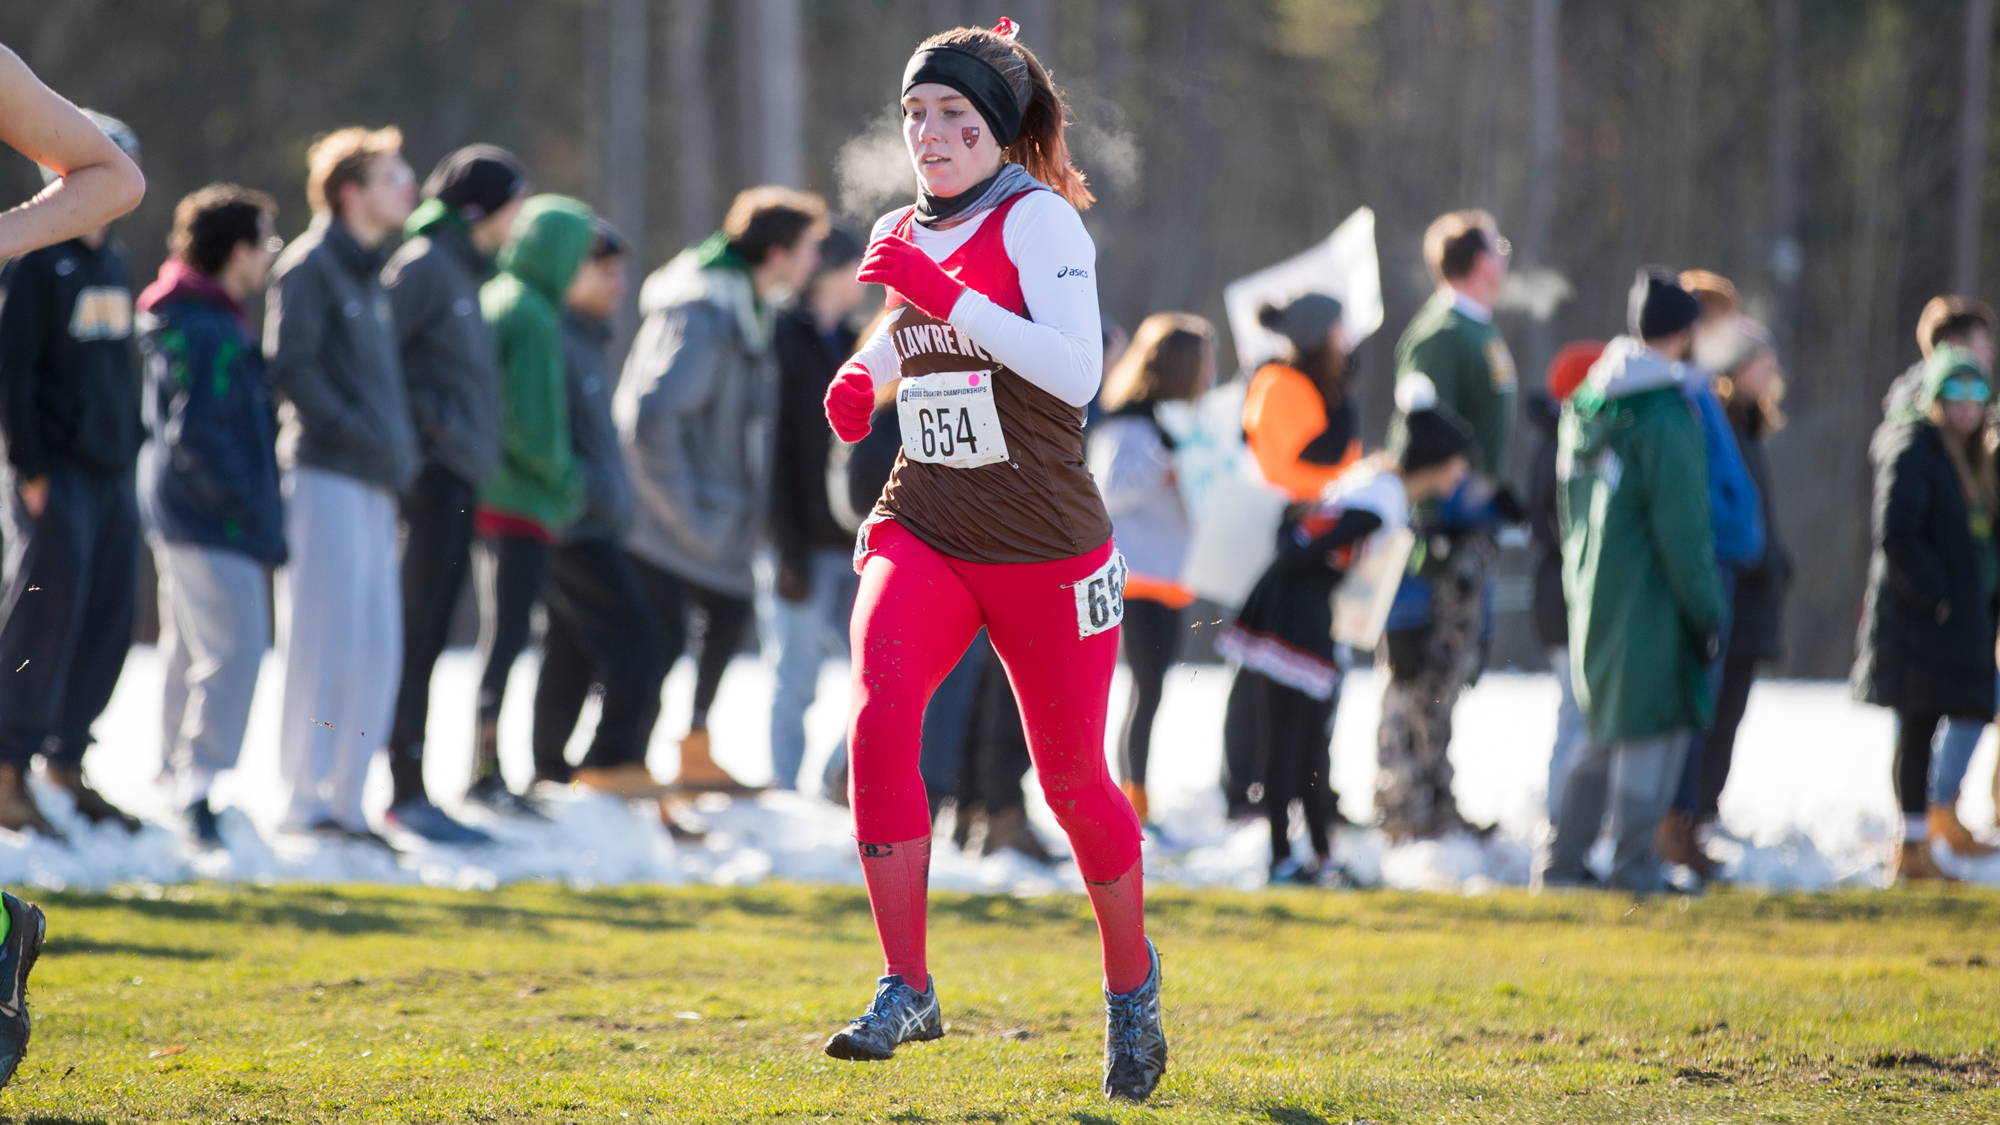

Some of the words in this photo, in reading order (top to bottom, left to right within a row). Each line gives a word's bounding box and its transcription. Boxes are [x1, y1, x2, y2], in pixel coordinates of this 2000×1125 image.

[1069, 268, 1088, 278] asics
[896, 324, 998, 362] LAWRENC
[923, 390, 942, 398] COUNTRY
[943, 386, 987, 397] CHAMPIONSHIPS
[919, 407, 977, 457] 654
